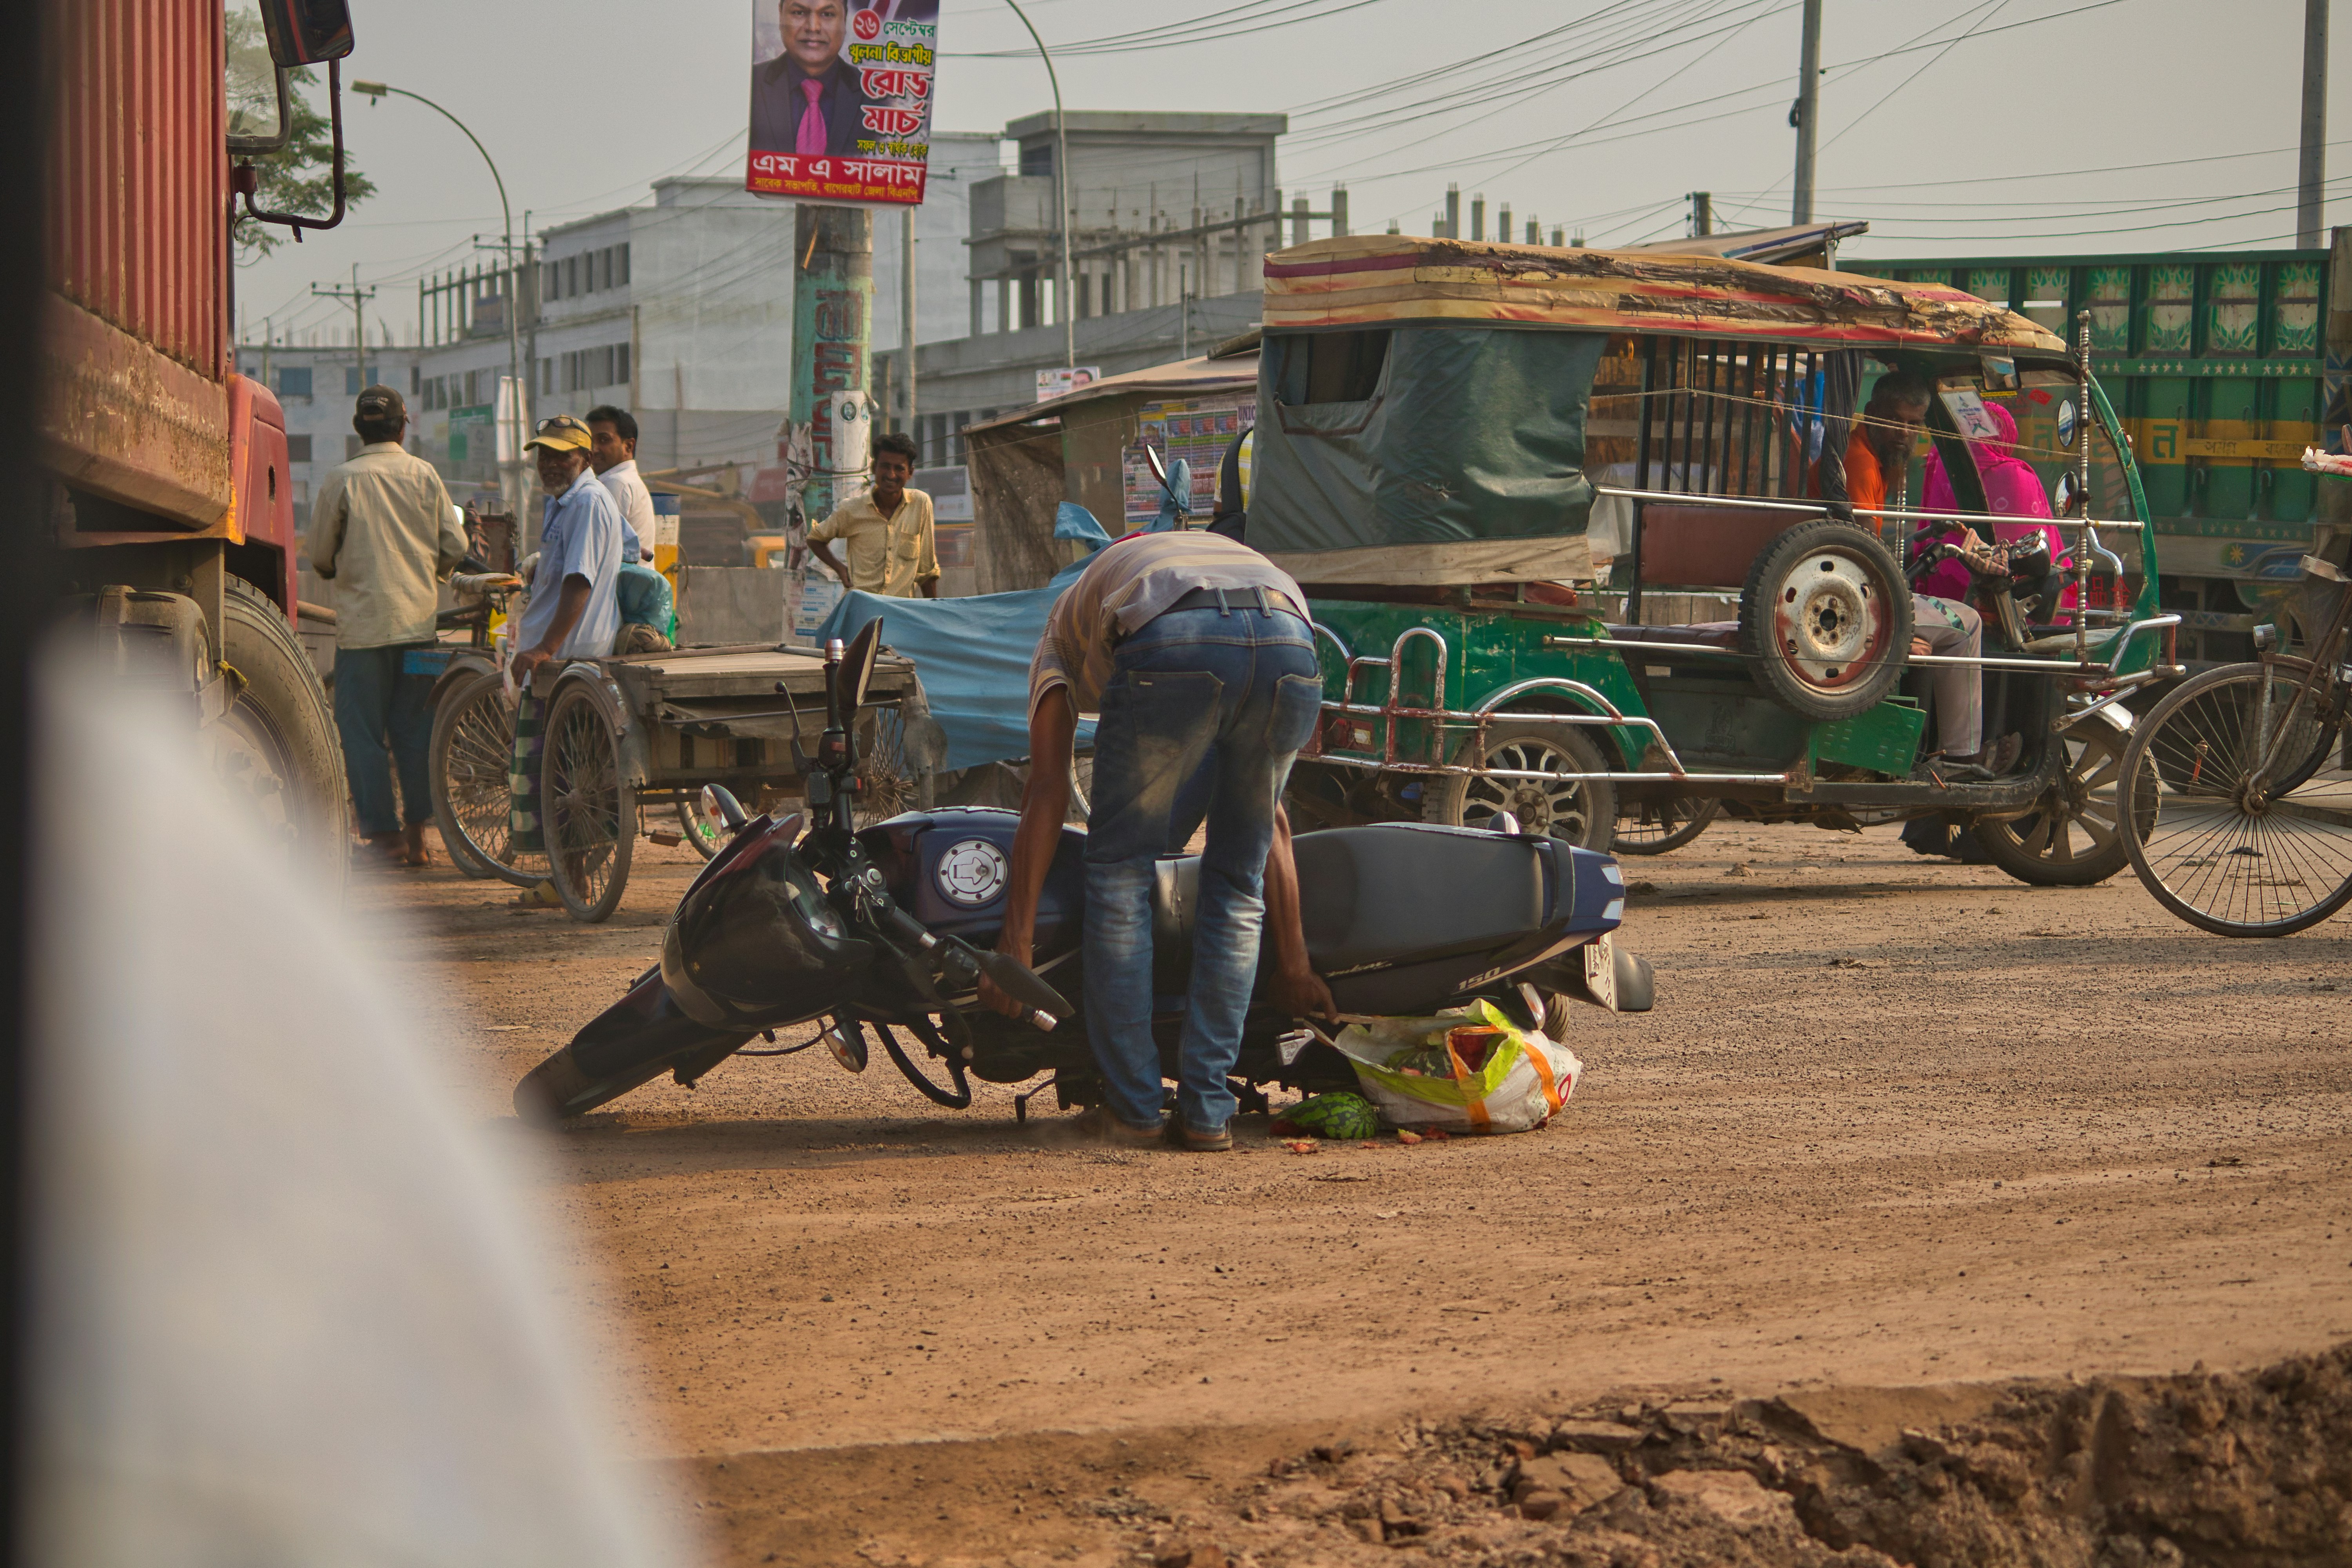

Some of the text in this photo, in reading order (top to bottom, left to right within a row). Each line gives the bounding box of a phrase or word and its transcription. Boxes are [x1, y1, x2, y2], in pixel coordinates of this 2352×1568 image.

[856, 16, 936, 37] ২৬ সেপ্টেম্বর
[849, 41, 934, 67] খুলনা বিভাগীয়
[858, 67, 932, 99] রোড
[860, 100, 925, 136] মার্চ
[857, 140, 876, 155] সফল
[878, 142, 885, 154] ও
[910, 143, 929, 160] হোক
[753, 155, 924, 185] এম এ সালাম
[755, 177, 782, 188] সাবেক
[824, 182, 862, 195] বাগেরহাট
[864, 186, 885, 197] জেলা
[1459, 967, 1501, 991] 150
